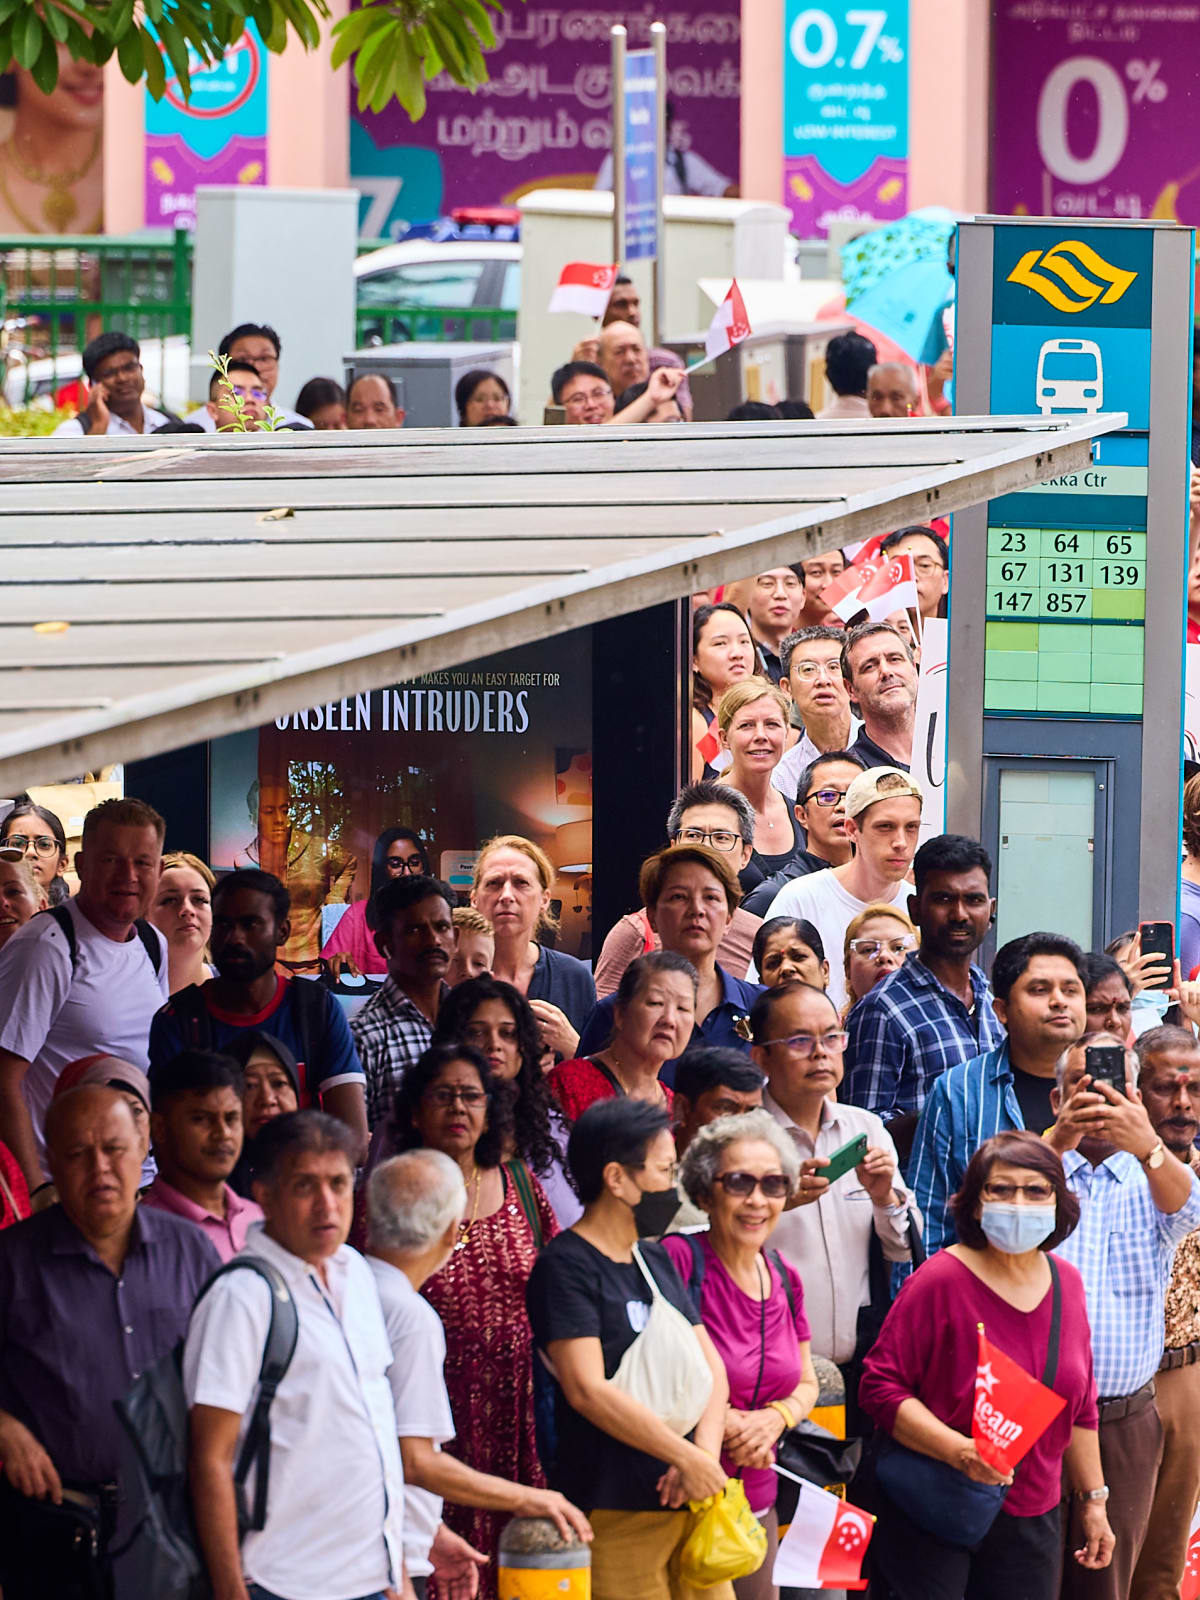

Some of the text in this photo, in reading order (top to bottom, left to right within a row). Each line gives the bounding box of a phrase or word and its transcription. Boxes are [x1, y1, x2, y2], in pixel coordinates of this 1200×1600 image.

[789, 8, 904, 70] 0.7%
[1084, 472, 1108, 488] Ctr
[1000, 533, 1132, 555] 23 64 65
[1001, 562, 1139, 585] 67 131 139
[994, 592, 1087, 613] 147 857
[421, 672, 449, 686] MAKES
[451, 673, 469, 686] YOU
[471, 673, 483, 686] AN
[486, 673, 507, 686] EASY
[510, 673, 540, 687] TARGET
[543, 673, 560, 687] FOR
[382, 689, 530, 734] INTRUDERS
[975, 1391, 1024, 1442] team
